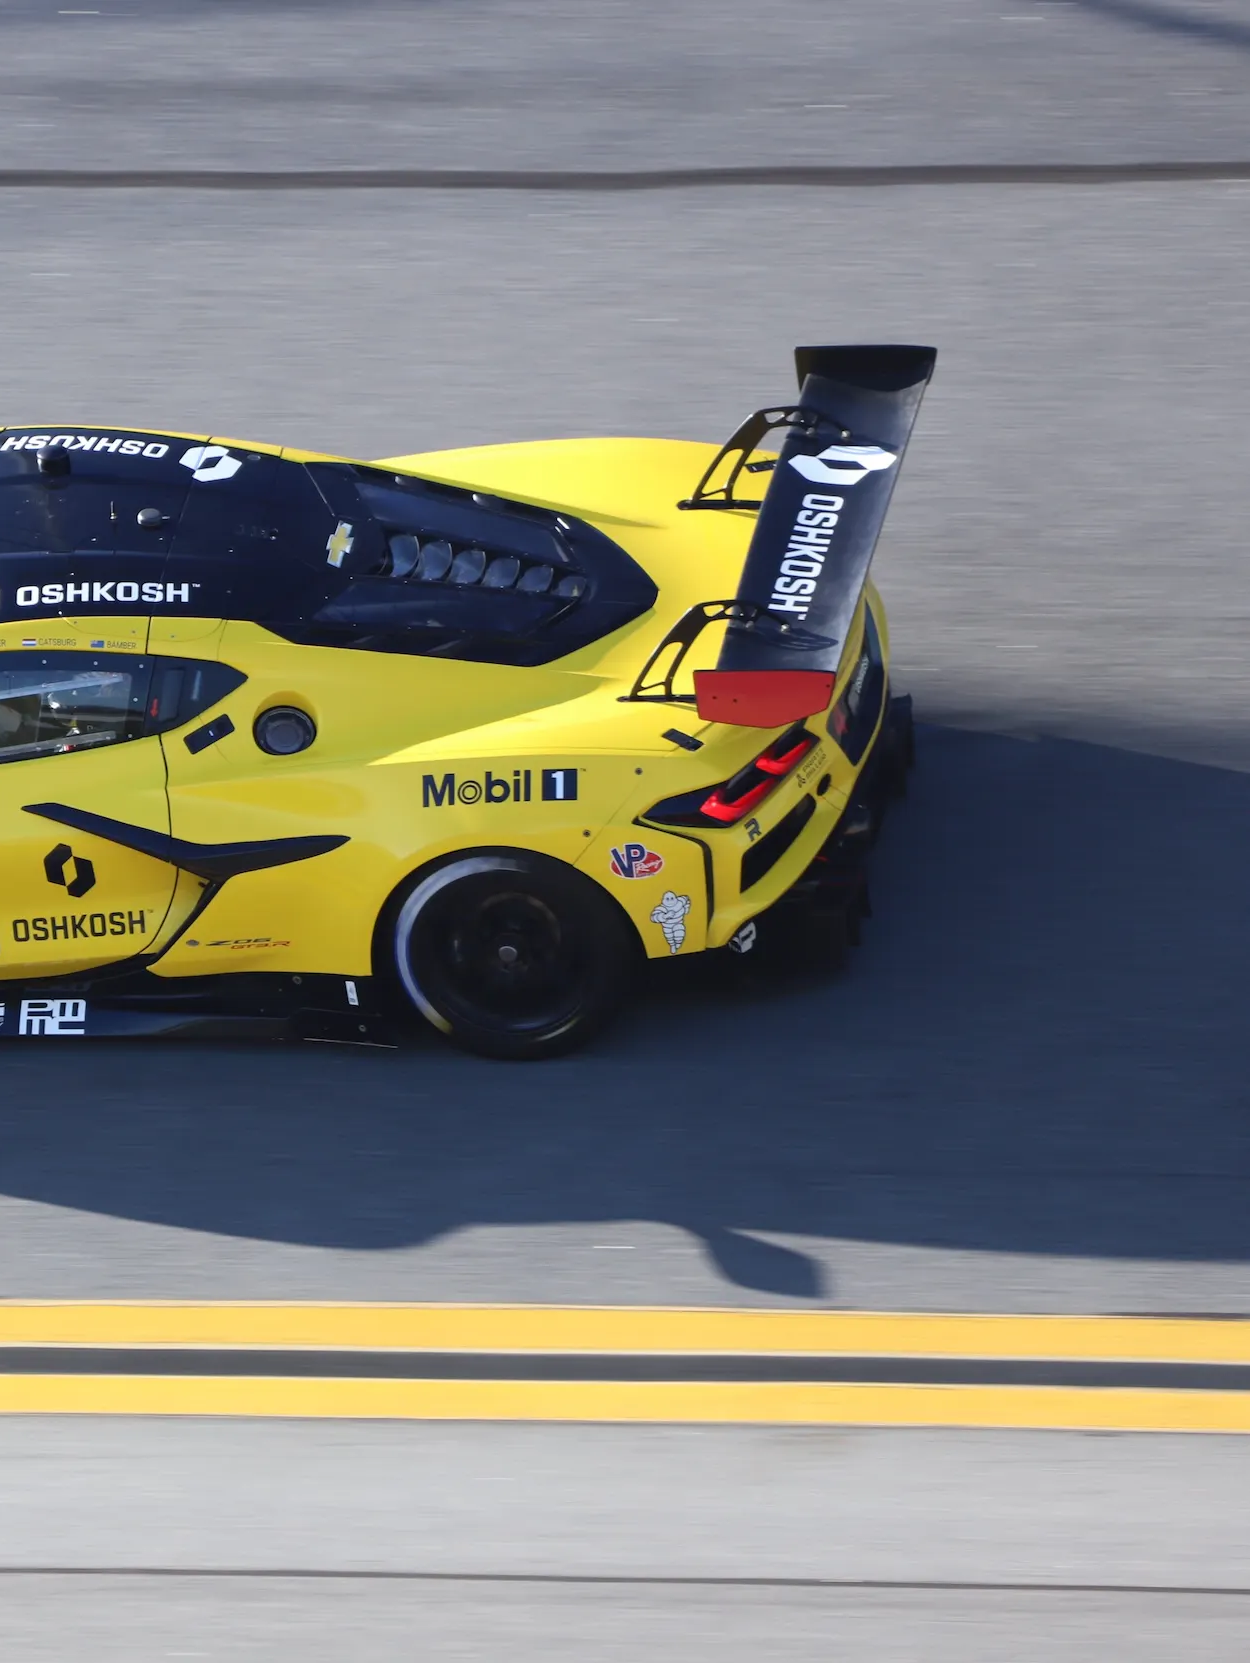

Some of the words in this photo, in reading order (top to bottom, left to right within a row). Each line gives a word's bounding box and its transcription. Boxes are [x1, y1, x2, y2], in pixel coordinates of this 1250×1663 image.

[39, 638, 77, 647] CATSBURG
[107, 641, 137, 649] BAMBER
[422, 770, 531, 808] Mobil
[611, 843, 646, 878] VP
[206, 938, 272, 947] Z06
